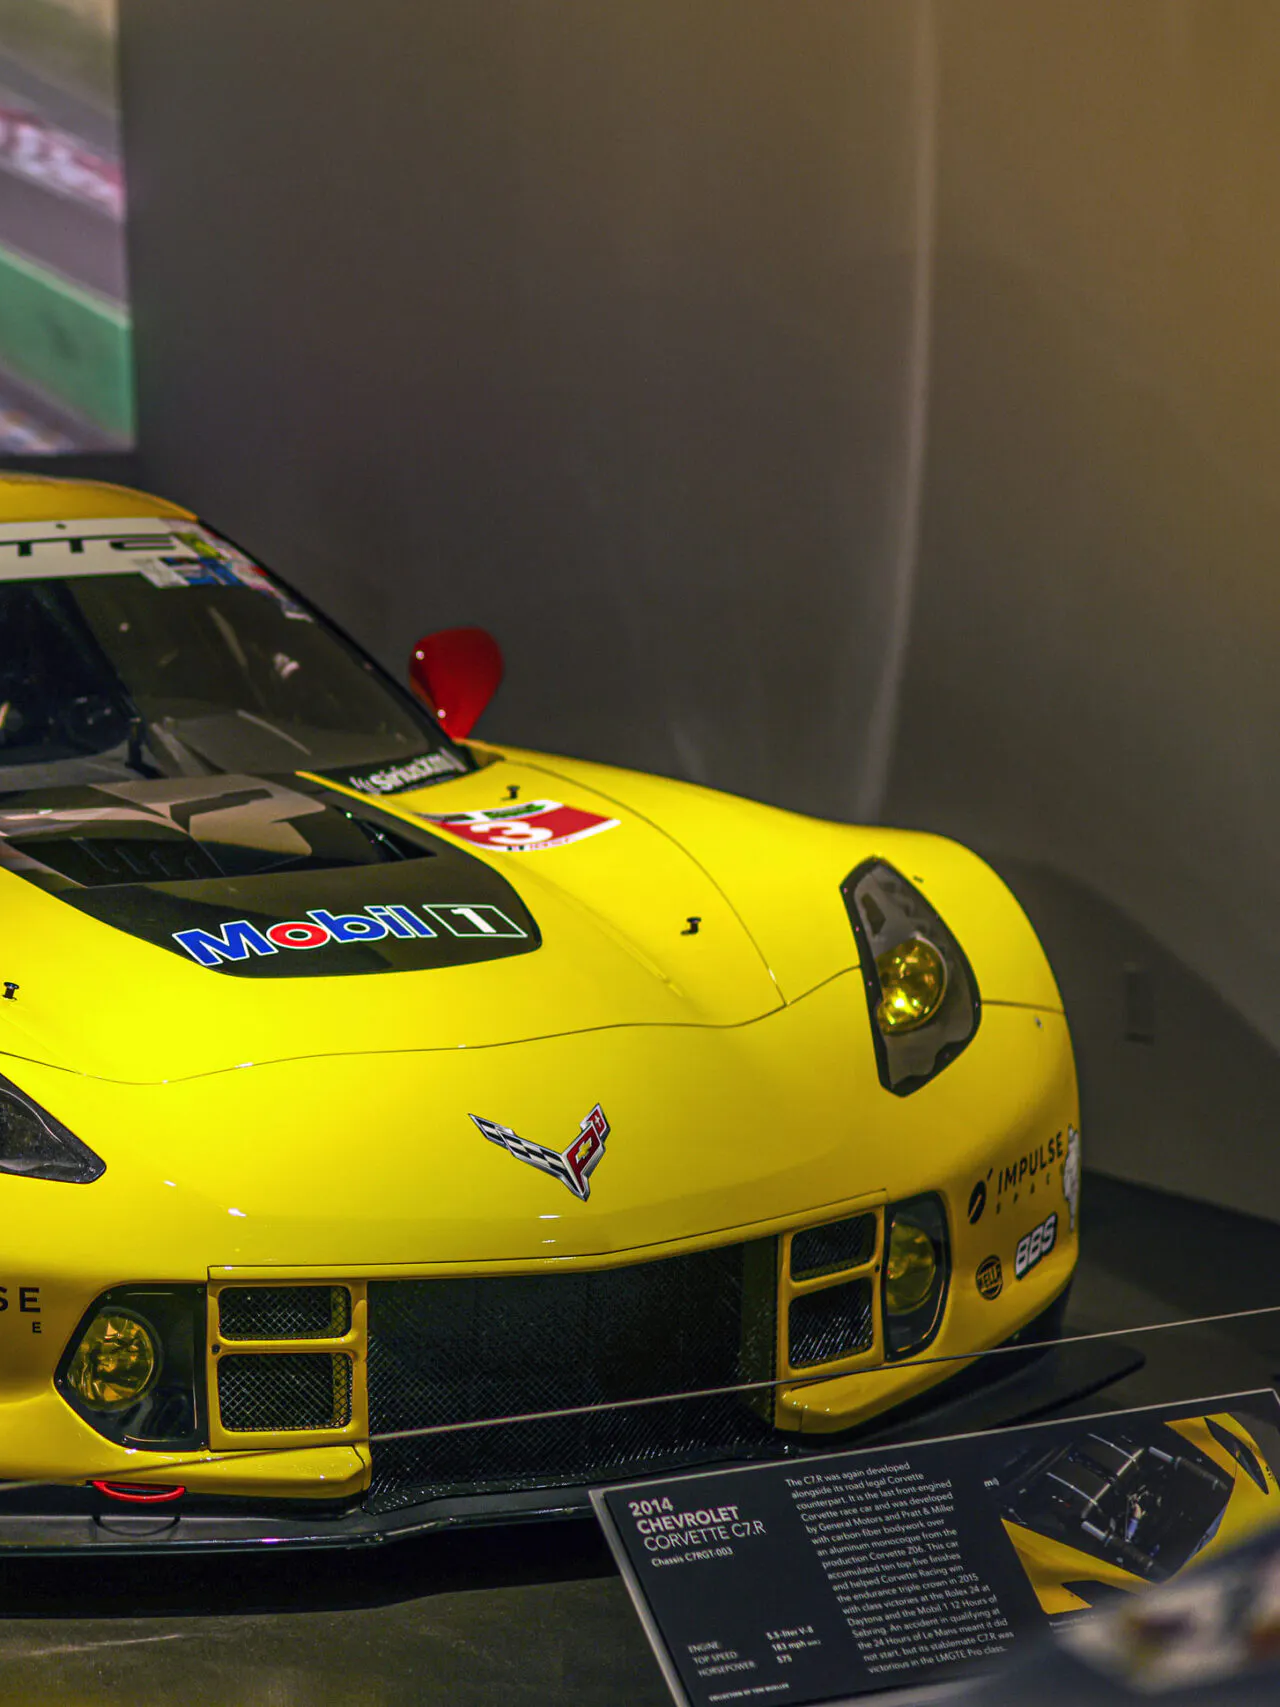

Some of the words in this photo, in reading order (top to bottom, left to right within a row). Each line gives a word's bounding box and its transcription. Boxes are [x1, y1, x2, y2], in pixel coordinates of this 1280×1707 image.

[470, 821, 553, 845] 3
[172, 905, 437, 966] Mobil
[450, 907, 498, 934] 1
[997, 1130, 1064, 1196] IMPULSE
[1015, 1212, 1058, 1281] BBS
[802, 1474, 823, 1484] C7.R
[841, 1470, 864, 1479] again
[844, 1481, 864, 1490] road
[865, 1478, 886, 1488] legal
[886, 1473, 923, 1484] Corvette
[879, 1488, 895, 1497] last
[628, 1496, 674, 1517] 2014
[800, 1510, 838, 1520] Corvette
[874, 1501, 890, 1510] and
[636, 1505, 739, 1535] CHEVROLET
[805, 1524, 817, 1533] by
[818, 1519, 852, 1530] General
[852, 1516, 882, 1525] Motors
[883, 1512, 900, 1521] and
[900, 1509, 922, 1518] Pratt
[930, 1505, 953, 1513] Miller
[643, 1526, 732, 1551] CORVETTE
[731, 1520, 767, 1539] C7.R
[811, 1535, 829, 1544] with
[882, 1521, 924, 1533] bodywork
[926, 1518, 944, 1526] over
[829, 1542, 869, 1553] aluminum
[921, 1531, 942, 1539] from
[651, 1554, 685, 1568] Chassis
[868, 1549, 906, 1559] Corvette
[906, 1545, 925, 1554] Z06.
[926, 1542, 944, 1551] This
[896, 1558, 928, 1568] top-five
[929, 1553, 960, 1562] finishes
[832, 1581, 848, 1590] and
[849, 1576, 879, 1588] helped
[880, 1572, 917, 1582] Corvette
[918, 1567, 947, 1576] Racing
[897, 1583, 920, 1593] triple
[922, 1580, 947, 1589] crown
[957, 1573, 978, 1583] 2015
[842, 1605, 860, 1614] with
[861, 1602, 882, 1611] class
[944, 1588, 967, 1597] Rolex
[968, 1585, 980, 1594] 24
[846, 1615, 882, 1626] Daytona
[884, 1610, 901, 1620] and
[916, 1604, 941, 1614] Mobil
[950, 1600, 960, 1608] 12
[961, 1598, 987, 1606] Hours
[988, 1595, 997, 1603] of
[852, 1627, 886, 1638] Sebring.
[903, 1618, 938, 1629] accident
[872, 1638, 884, 1647] 24
[884, 1635, 911, 1644] Hours
[912, 1632, 921, 1640] of
[933, 1628, 957, 1637] Mans
[958, 1622, 984, 1632] meant
[993, 1618, 1007, 1627] did
[863, 1652, 878, 1661] not
[879, 1649, 901, 1658] start,
[901, 1646, 917, 1655] but
[976, 1632, 996, 1642] C7.R
[919, 1656, 934, 1664] the
[935, 1650, 966, 1662] LMGTE
[983, 1645, 1005, 1654] class.
